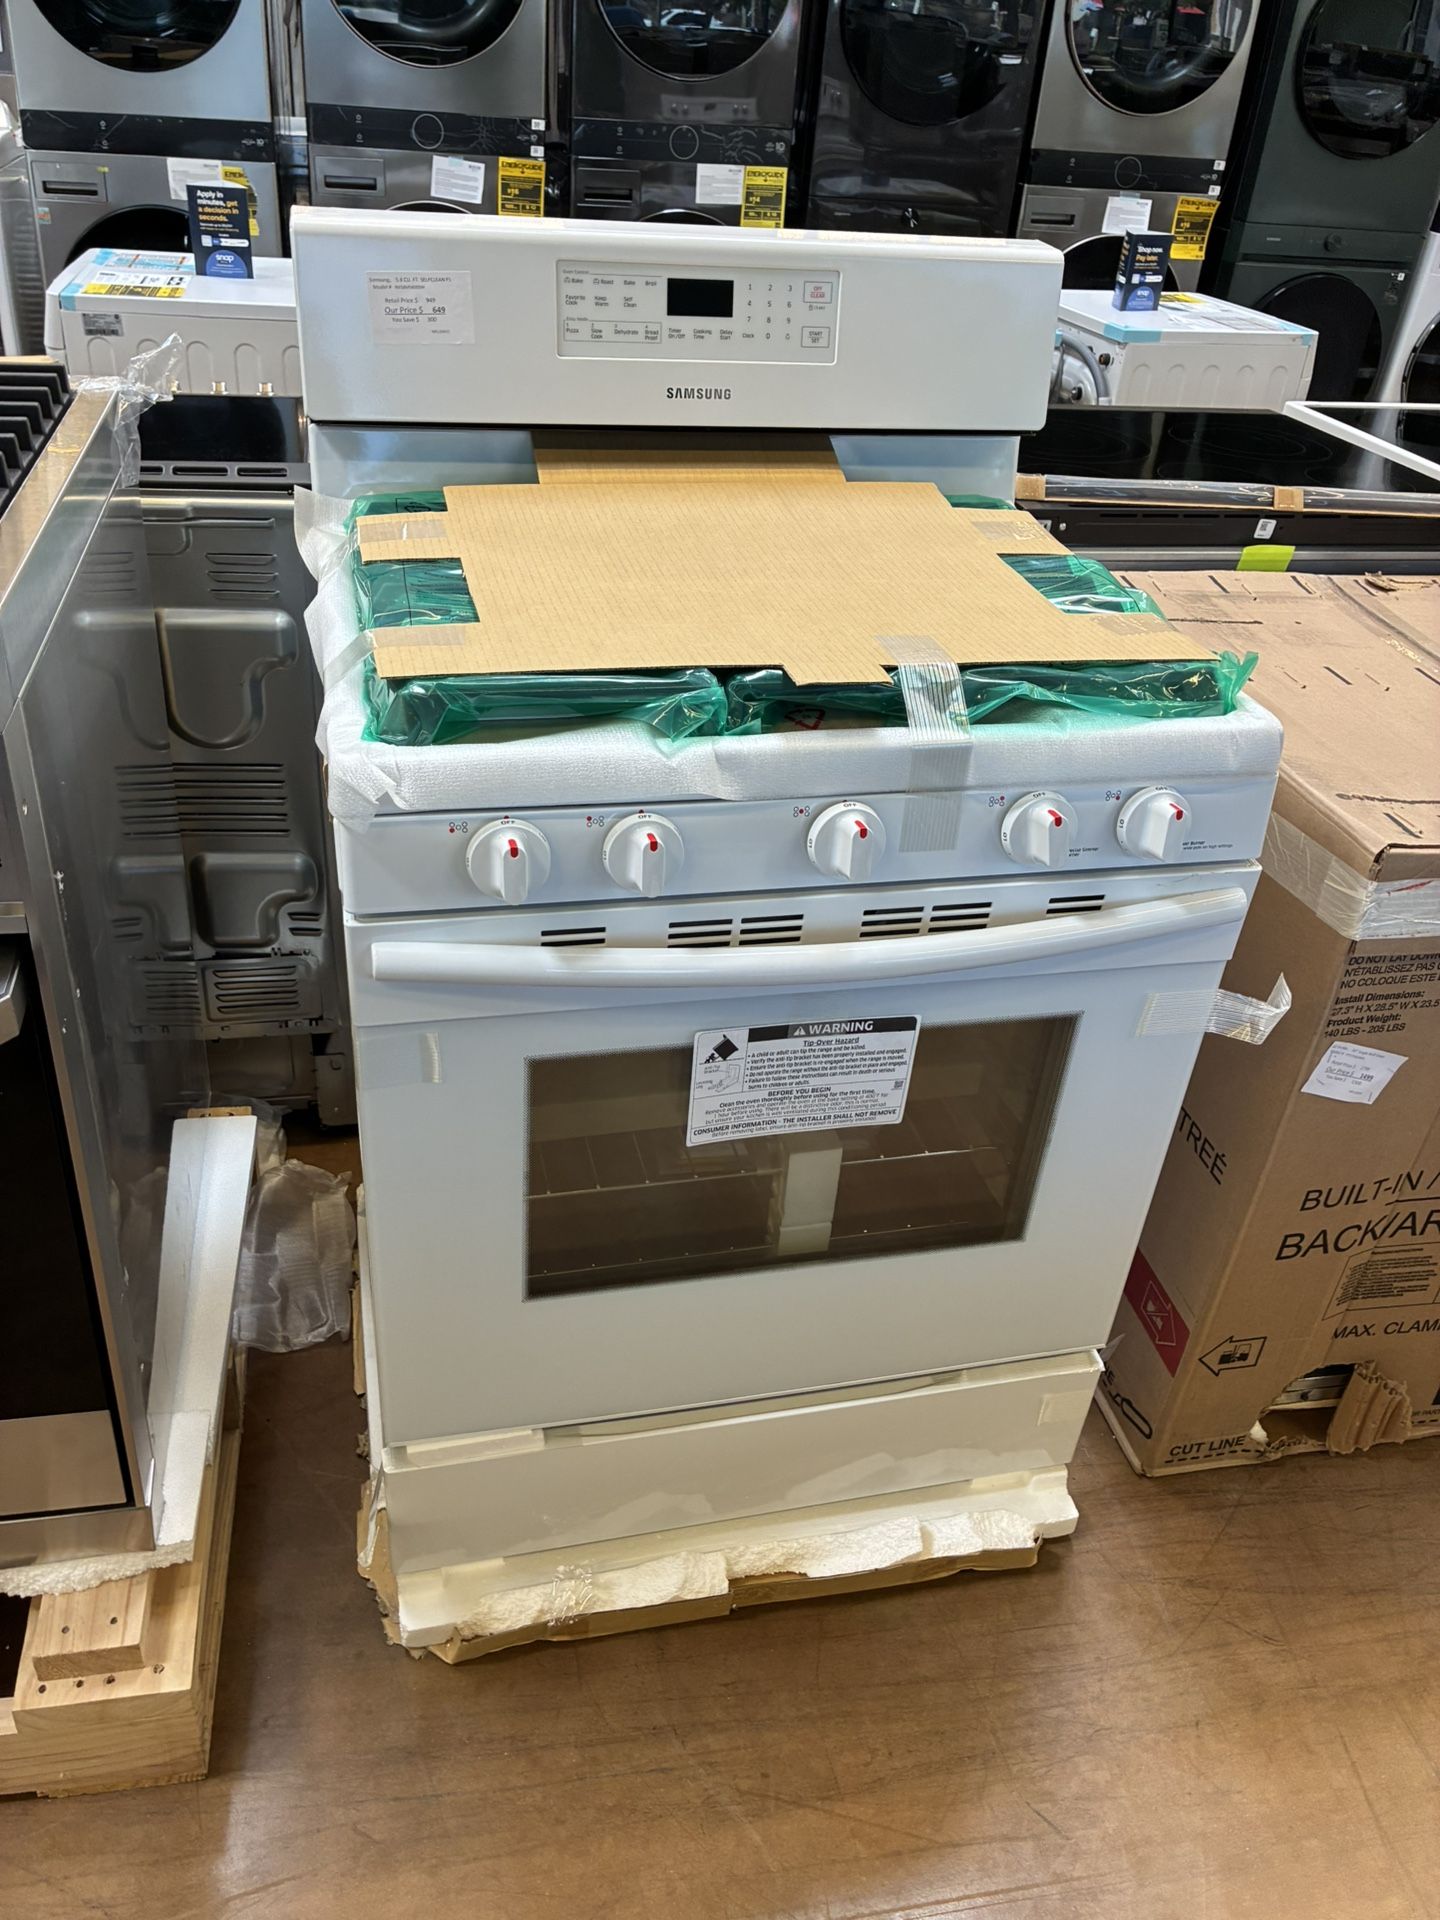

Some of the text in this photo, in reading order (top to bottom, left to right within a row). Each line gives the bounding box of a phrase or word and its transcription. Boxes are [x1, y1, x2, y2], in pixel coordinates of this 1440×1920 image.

[197, 190, 216, 198] Apply
[216, 254, 234, 263] snap
[419, 306, 424, 314] $
[666, 388, 731, 400] SAMSUNG
[1349, 957, 1364, 965] DO
[1366, 955, 1386, 964] NOT
[1415, 962, 1436, 971] PAS
[1340, 980, 1356, 989] NO
[1357, 975, 1409, 986] COLOQUE
[1335, 991, 1425, 1005] Install Dimensions:
[1364, 1004, 1374, 1012] X
[1400, 1001, 1411, 1009] W
[1327, 1013, 1401, 1027] Product Weight:
[809, 1021, 874, 1035] WARNING
[1340, 1027, 1360, 1036] LBS
[1367, 1024, 1385, 1033] 205
[1386, 1023, 1406, 1032] LBS
[803, 1038, 833, 1047] Tip-Over
[693, 1125, 729, 1135] CONSUMER
[730, 1119, 776, 1129] INFORMATION
[1300, 1170, 1424, 1211] BUILT-IN
[1333, 1323, 1376, 1339] MAX.
[1169, 1435, 1247, 1457] CUT LINE
